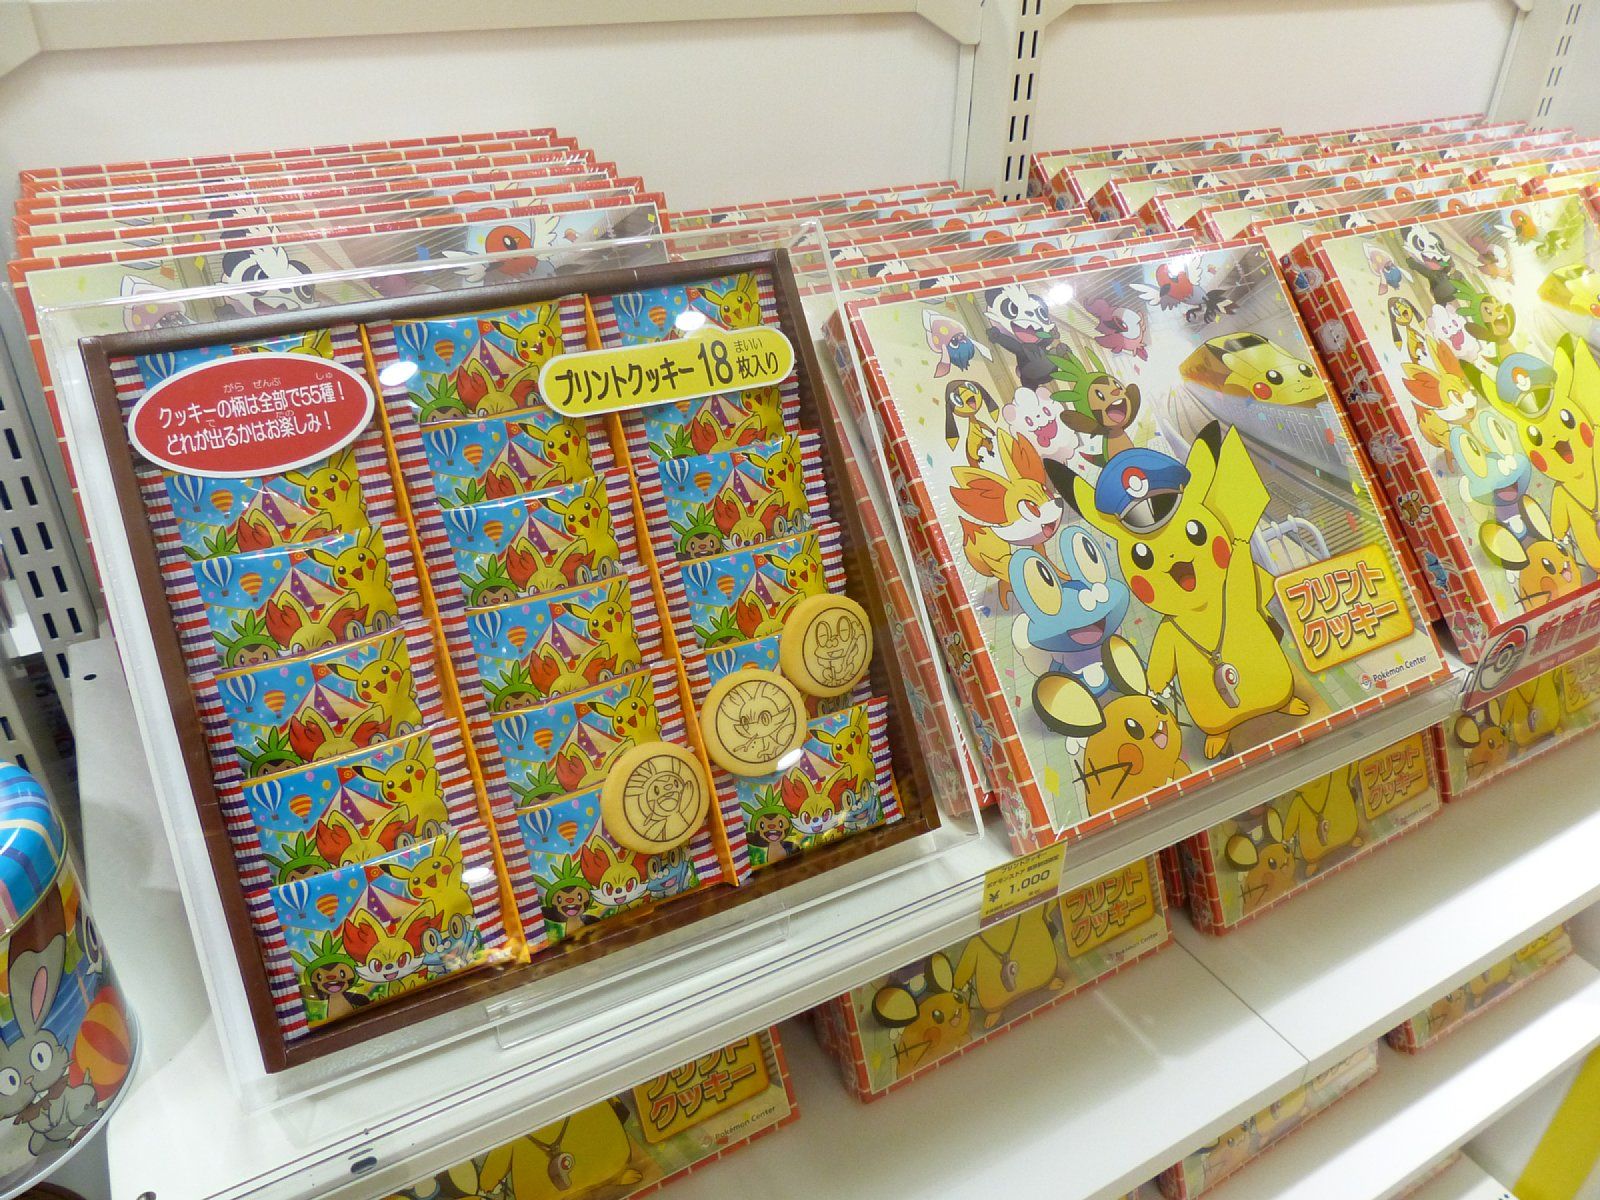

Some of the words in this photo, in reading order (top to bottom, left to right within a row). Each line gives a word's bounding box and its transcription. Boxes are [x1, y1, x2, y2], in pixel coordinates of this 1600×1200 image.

[167, 410, 333, 456] どれが出るかはお楽しみ！
[1286, 561, 1385, 621] プリント
[1304, 600, 1399, 658] クッキー
[1405, 654, 1427, 670] Center
[989, 890, 1000, 902] ¥
[1066, 867, 1143, 921] プリント
[1071, 894, 1147, 949] クッキー
[650, 1062, 757, 1131] クッキー
[750, 1105, 776, 1122] Center
